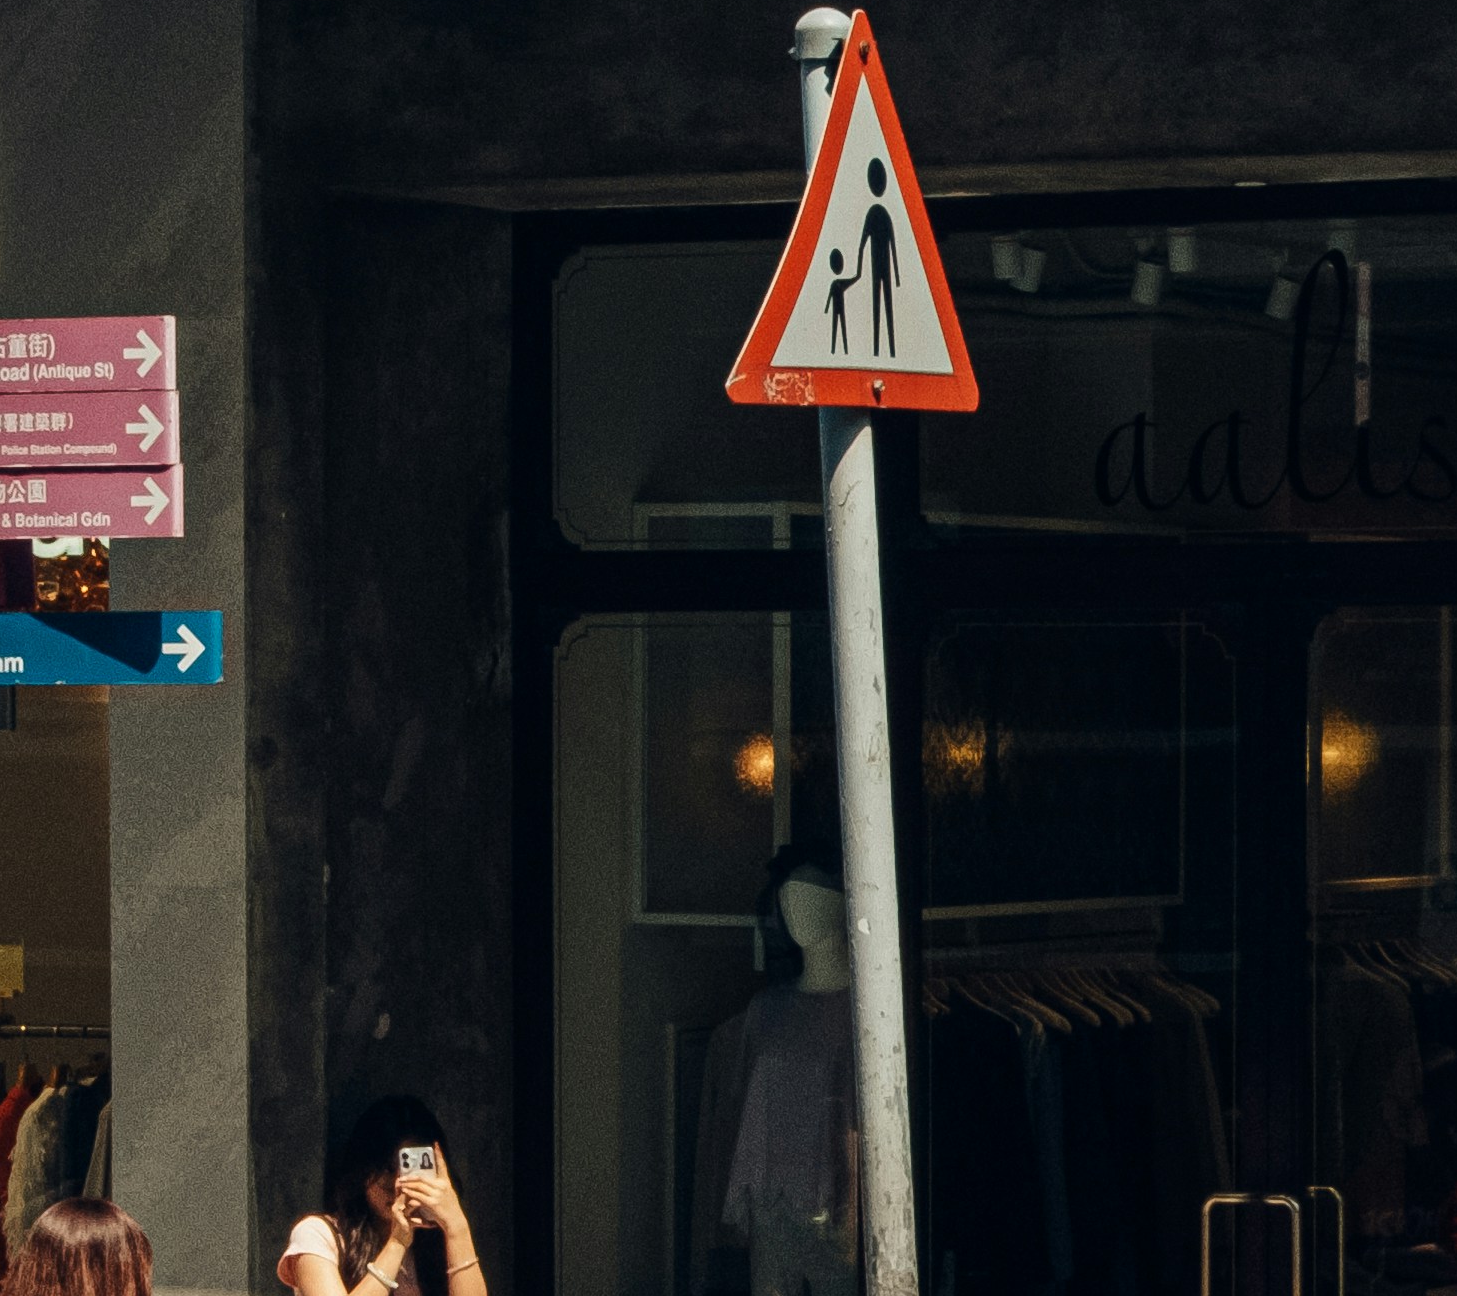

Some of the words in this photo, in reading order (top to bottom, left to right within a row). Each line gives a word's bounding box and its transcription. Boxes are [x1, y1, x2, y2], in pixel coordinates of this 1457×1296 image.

[33, 362, 92, 382] (Antique
[94, 361, 115, 381] St)
[2, 444, 29, 455] Police
[30, 443, 62, 455] Station
[63, 442, 118, 456] Compound)
[2, 513, 12, 528] &
[15, 512, 78, 528] Botanical
[80, 510, 111, 527] Gdn
